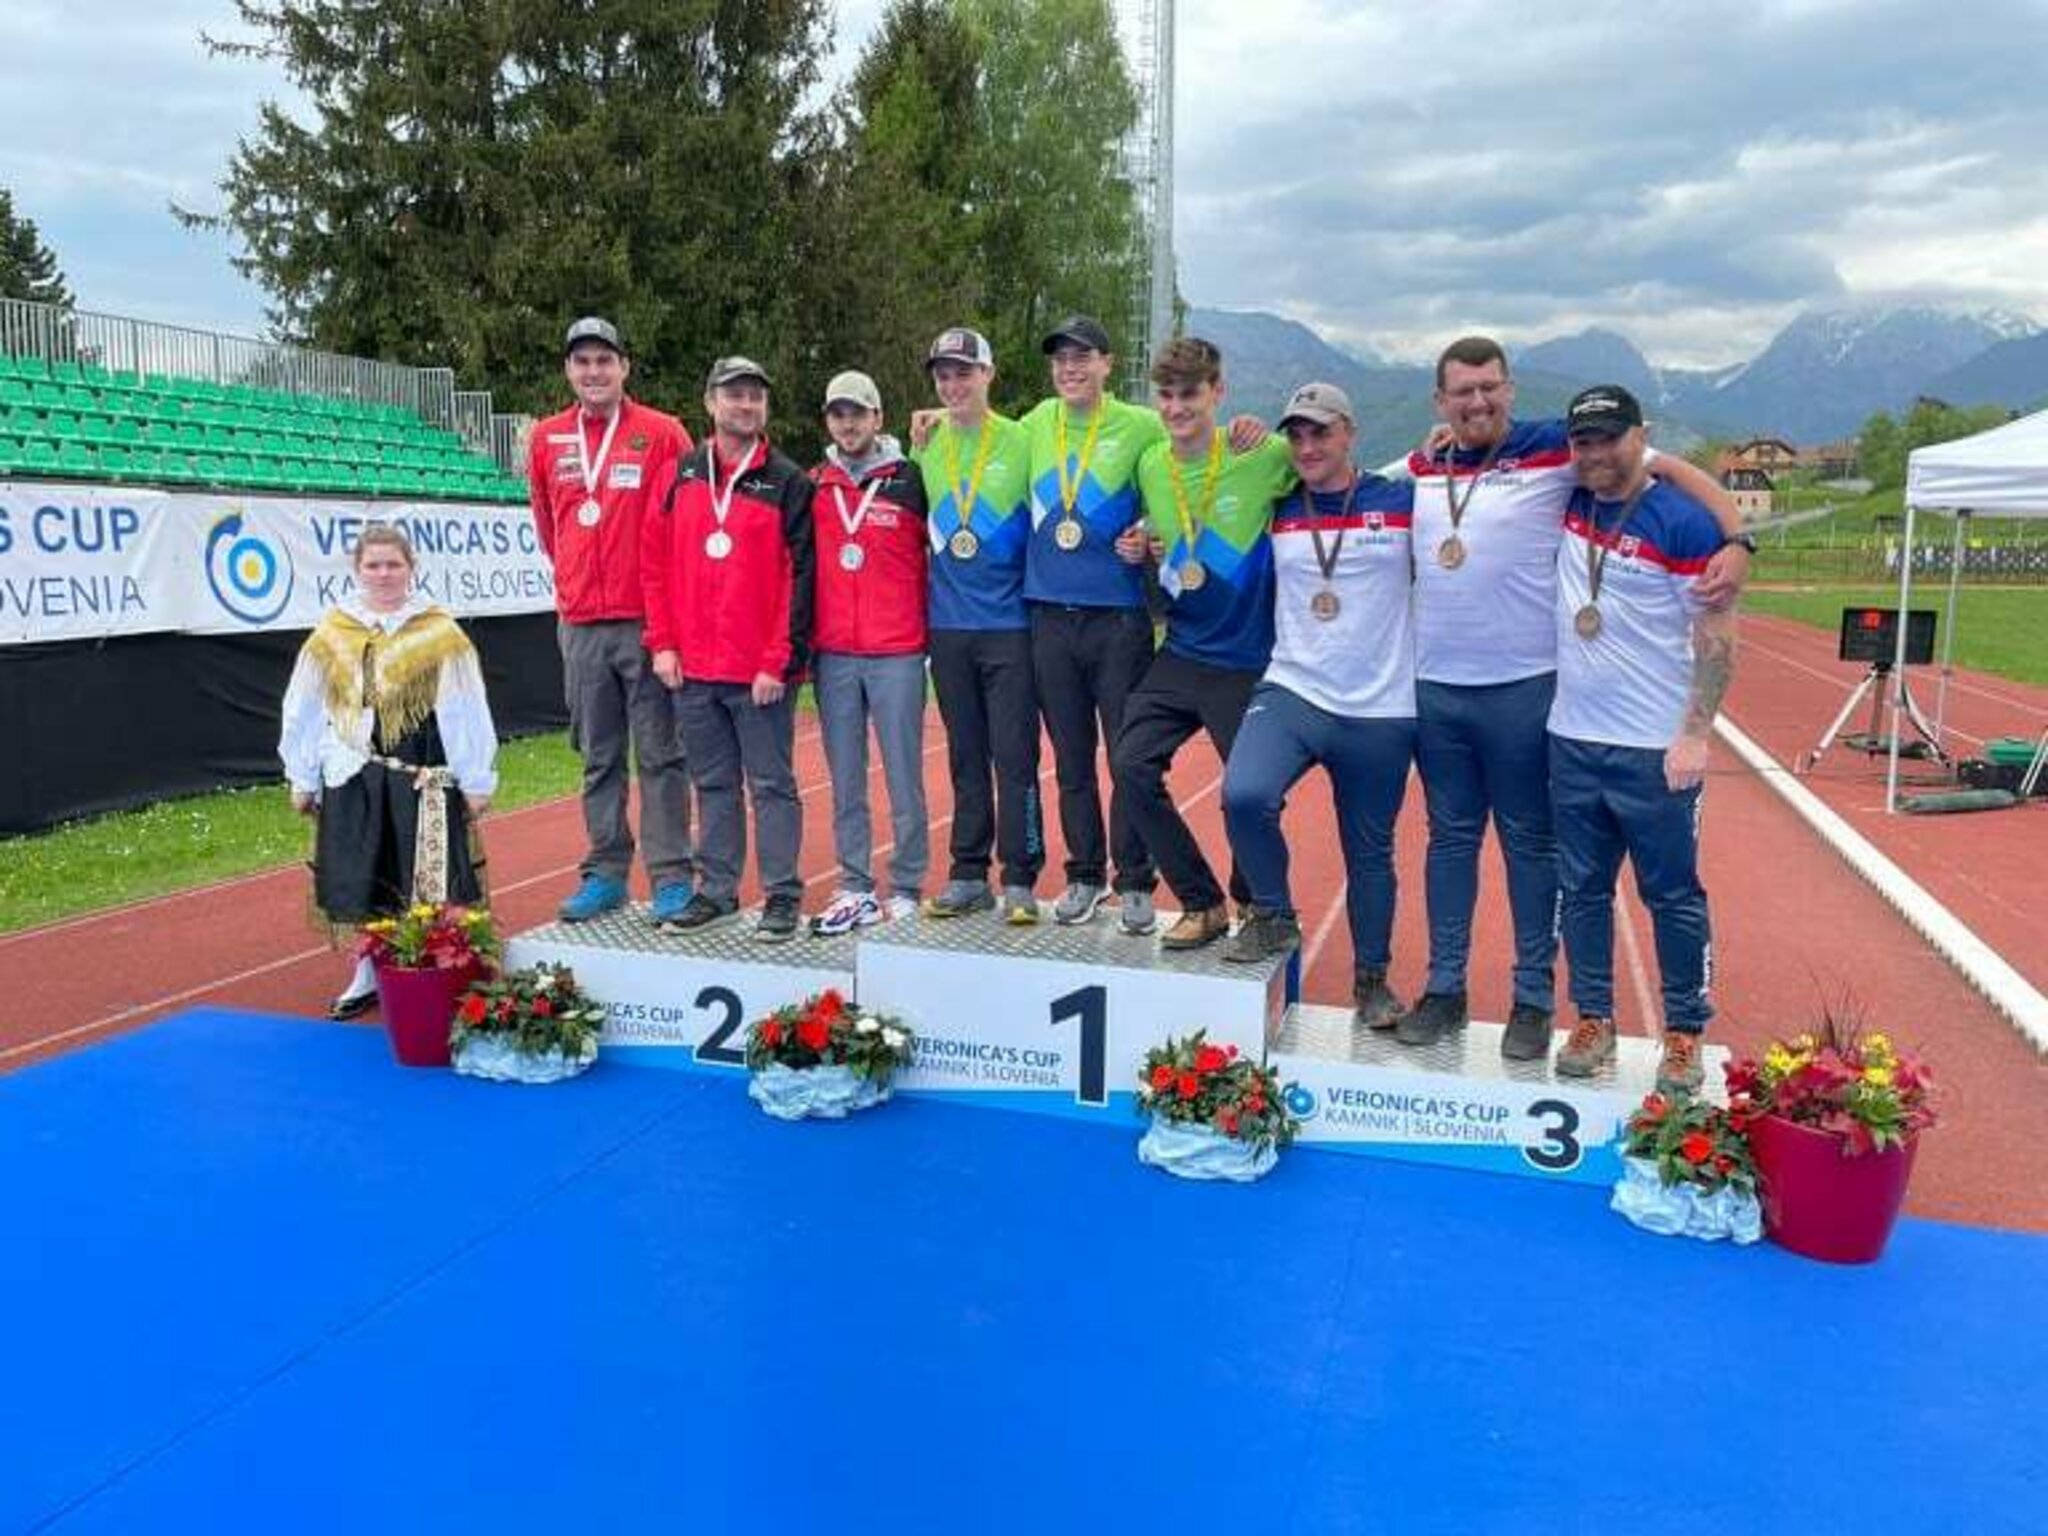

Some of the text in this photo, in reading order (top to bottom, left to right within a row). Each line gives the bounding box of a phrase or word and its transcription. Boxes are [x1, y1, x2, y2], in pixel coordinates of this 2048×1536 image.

[33, 505, 139, 553] CUP
[310, 516, 510, 555] VENICA'S
[0, 575, 147, 617] VENIA
[460, 567, 553, 601] SLOVEN
[650, 1006, 684, 1024] CUP
[694, 986, 744, 1065] 2
[911, 1036, 1061, 1067] VERONICA'S CUP
[1049, 985, 1106, 1103] 1
[981, 1063, 1061, 1087] SLOVENIA
[1327, 1086, 1511, 1124] VERONICA'S CUP
[1324, 1107, 1399, 1131] KAMNIK
[1414, 1116, 1508, 1144] SLOVENIA
[1525, 1099, 1580, 1169] 3
